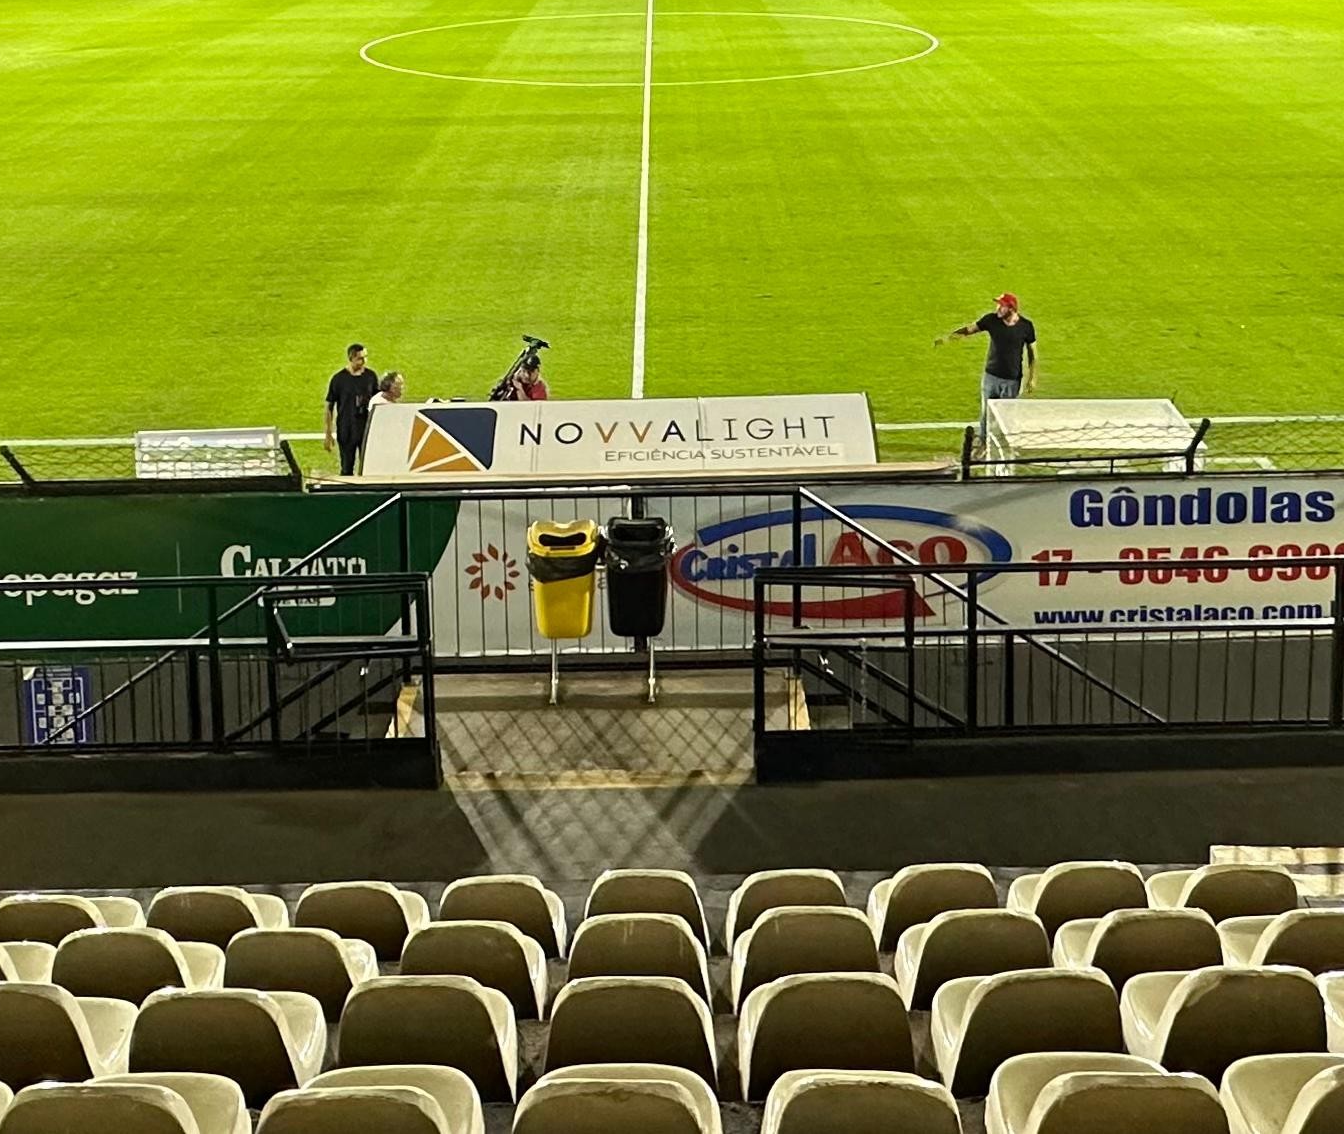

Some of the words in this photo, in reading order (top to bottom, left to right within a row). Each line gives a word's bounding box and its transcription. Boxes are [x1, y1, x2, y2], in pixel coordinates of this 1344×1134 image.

[519, 415, 836, 446] NOVVALIGHT
[604, 447, 706, 463] EFICIÊNCIA
[710, 442, 840, 461] SUSTENTÁVEL
[1069, 484, 1338, 528] Gôndolas
[1031, 549, 1073, 586] 17
